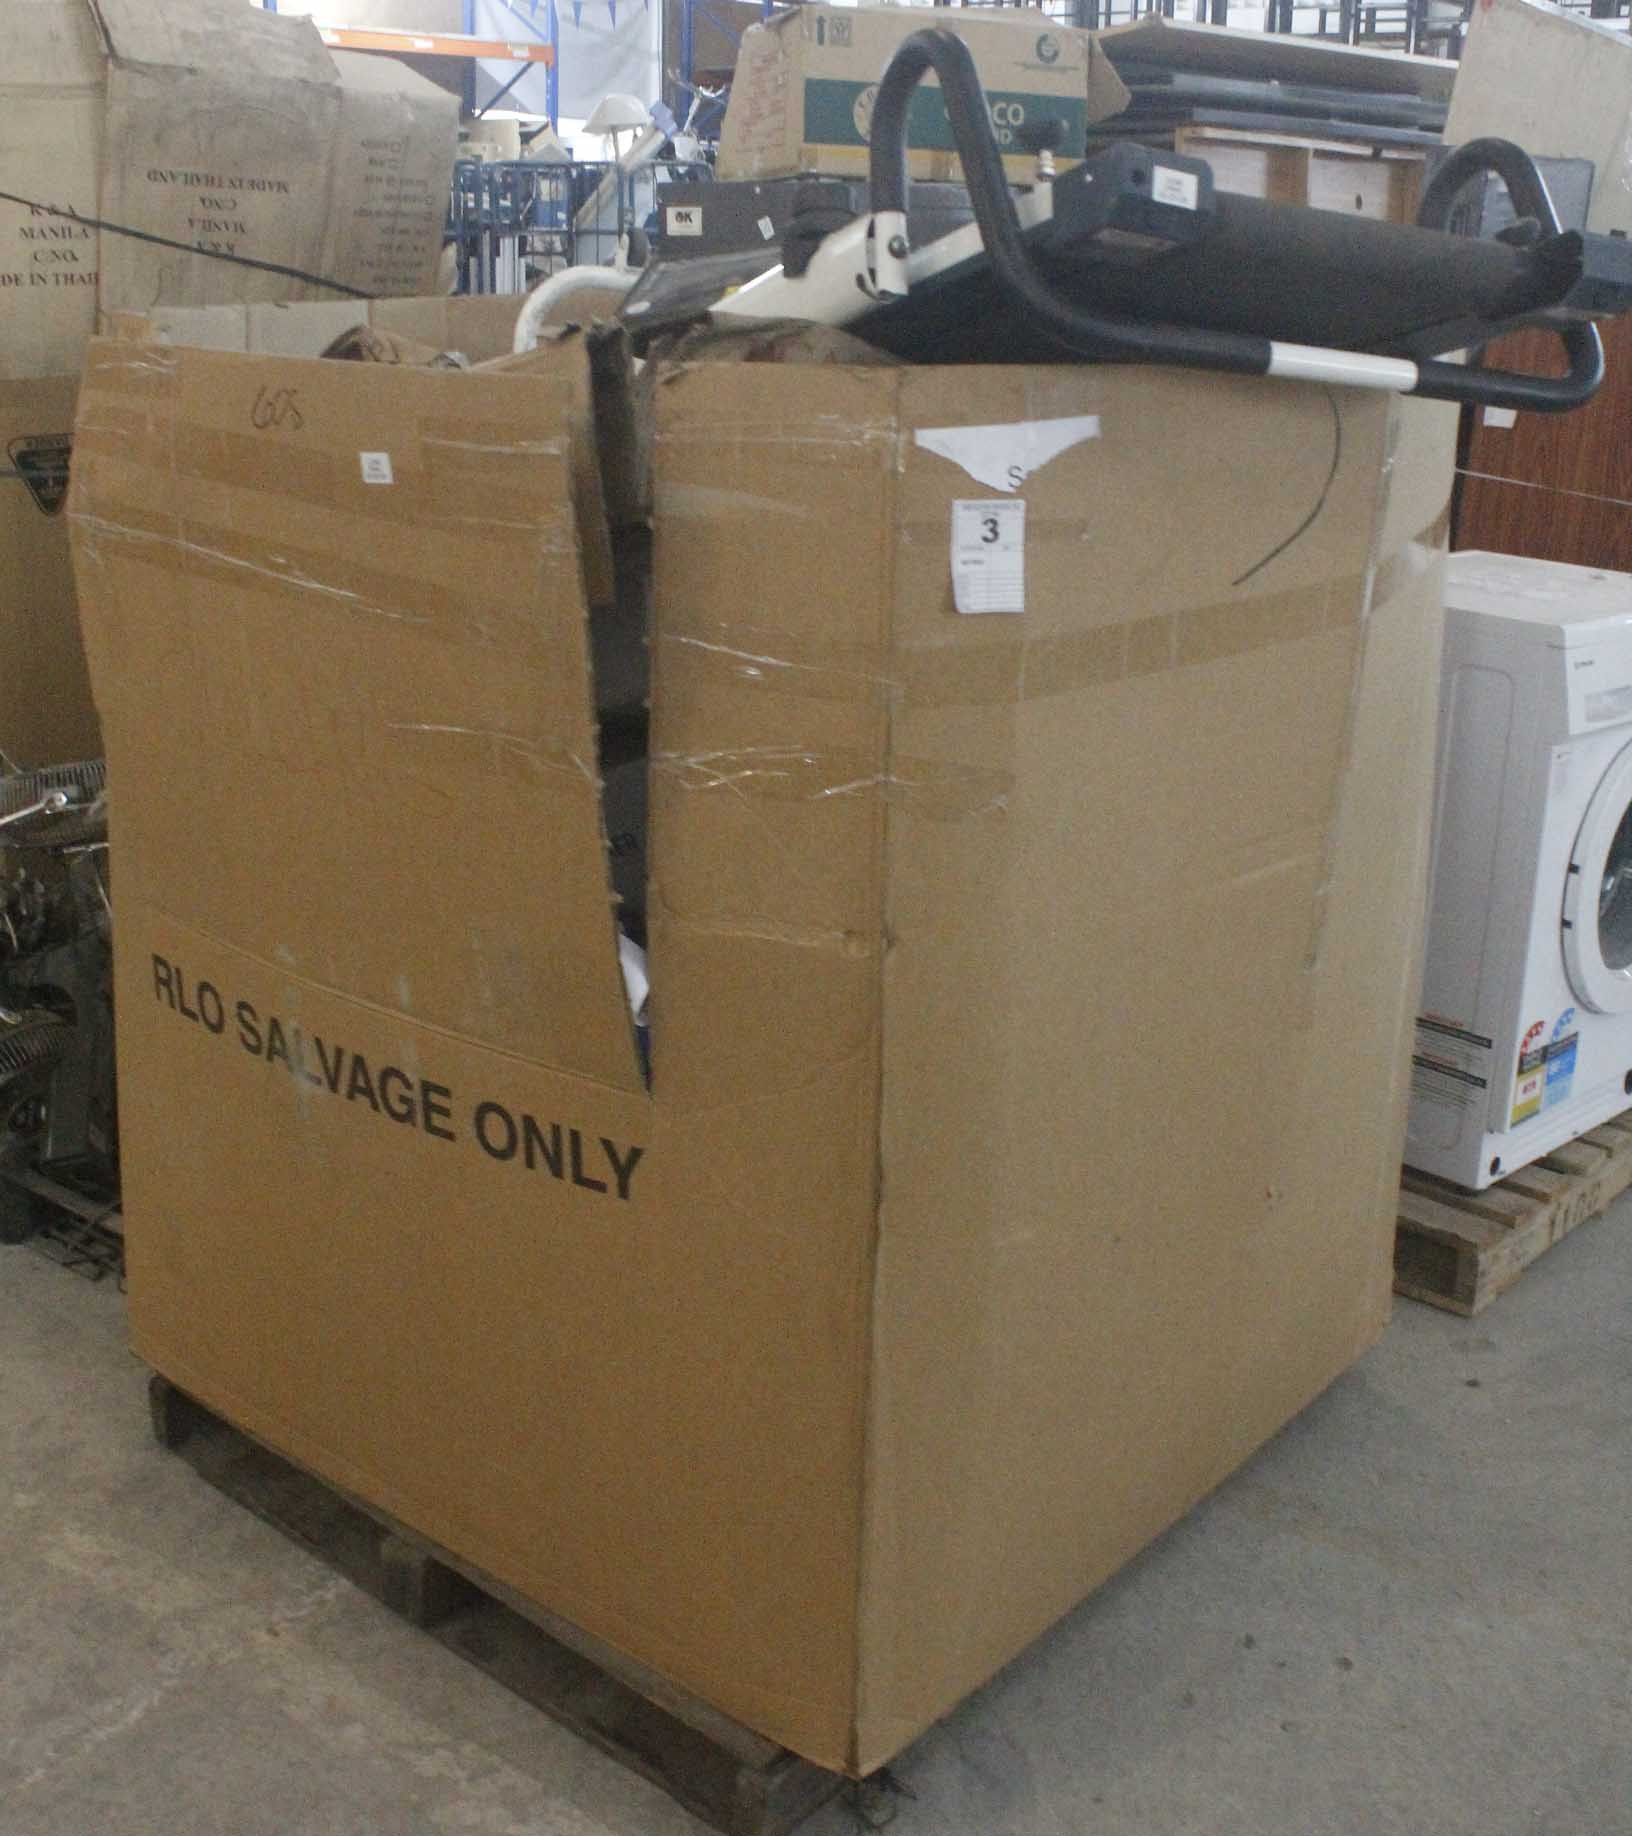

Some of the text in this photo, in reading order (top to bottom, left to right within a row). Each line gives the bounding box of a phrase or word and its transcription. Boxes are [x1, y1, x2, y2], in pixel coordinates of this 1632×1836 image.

[146, 169, 290, 194] MADE IN THAILAND
[187, 217, 247, 235] MANILA
[675, 210, 693, 225] OK
[19, 225, 91, 241] MANILA
[29, 272, 48, 287] IN
[980, 517, 1000, 544] 3
[152, 951, 646, 1201] RLO SALVAGE ONLY
